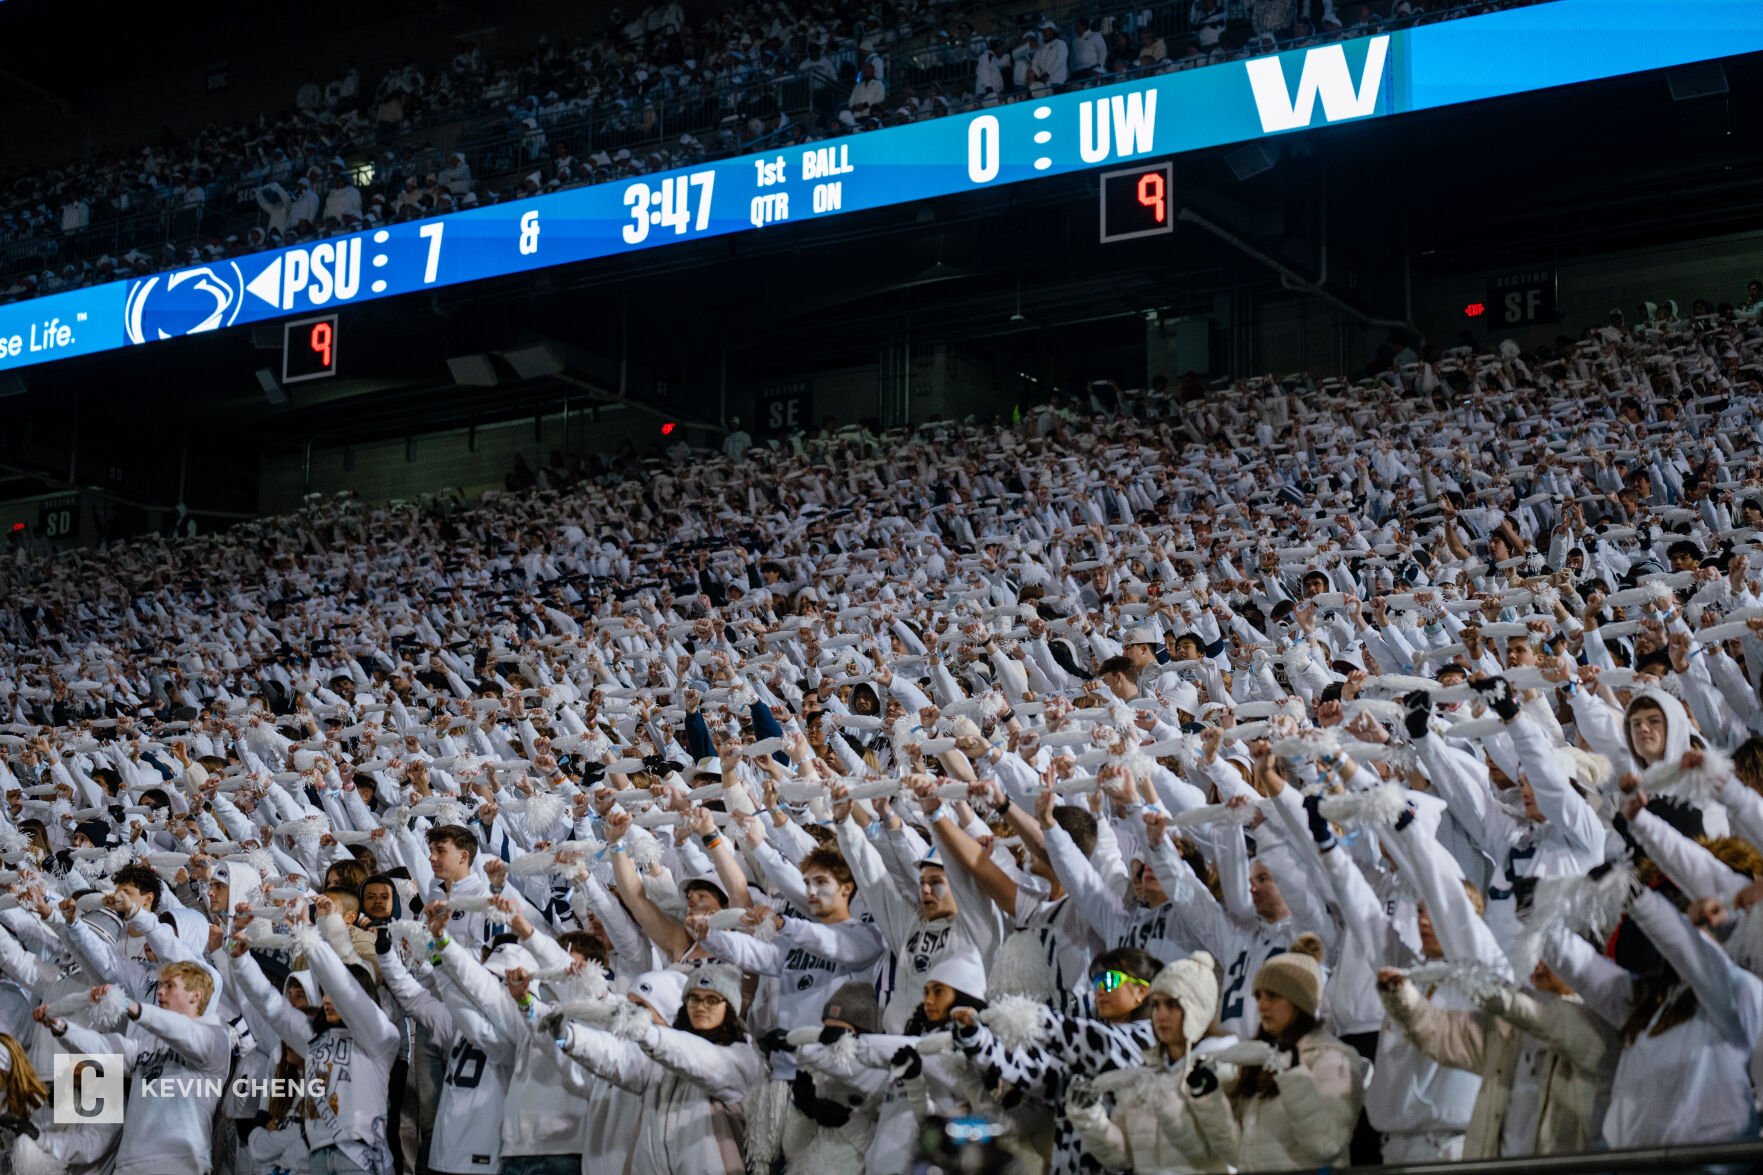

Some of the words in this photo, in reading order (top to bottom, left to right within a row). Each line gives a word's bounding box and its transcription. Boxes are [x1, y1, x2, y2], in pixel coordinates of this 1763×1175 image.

[1245, 35, 1390, 133] W
[1079, 89, 1158, 163] UW
[755, 156, 787, 187] 1st
[802, 144, 854, 181] BALL
[968, 116, 999, 182] 0
[622, 170, 715, 244] 3:47
[750, 192, 789, 228] QTR
[813, 181, 842, 213] ON
[1137, 172, 1165, 223] 9
[420, 222, 444, 284] 7
[519, 210, 540, 255] &
[282, 237, 362, 309] PSU
[1504, 288, 1542, 323] SF
[310, 322, 333, 367] 9
[768, 397, 801, 429] SE
[47, 511, 71, 537] SD
